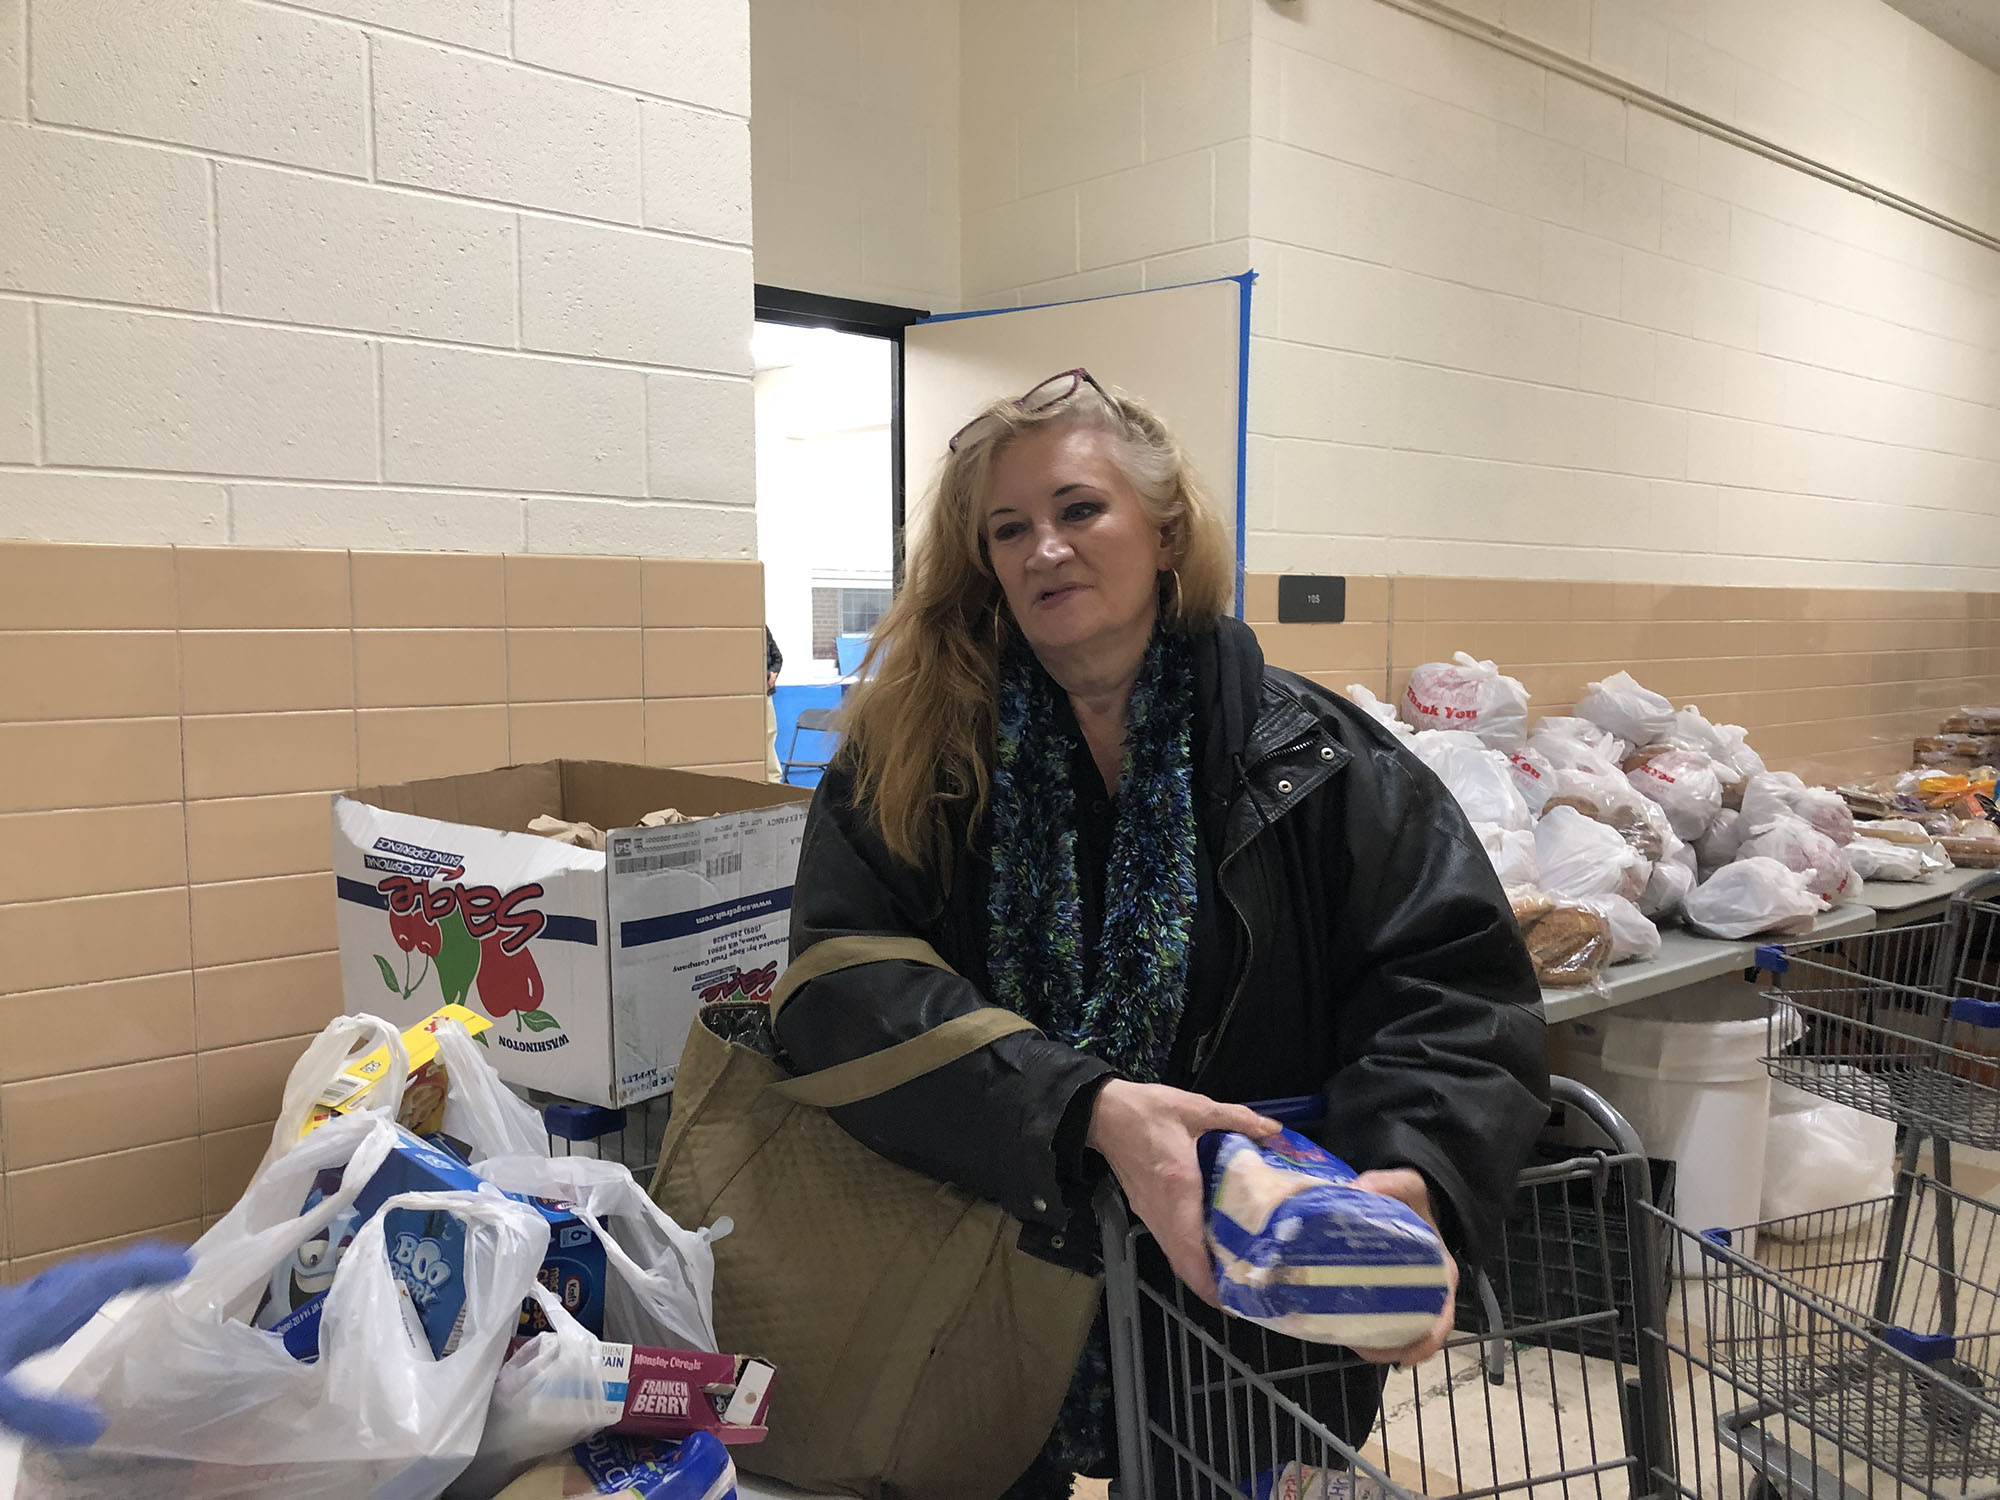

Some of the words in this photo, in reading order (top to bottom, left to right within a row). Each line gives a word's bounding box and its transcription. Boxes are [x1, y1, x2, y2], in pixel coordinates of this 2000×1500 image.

[1307, 594, 1321, 604] 105
[1405, 686, 1439, 717] Thank
[1444, 706, 1478, 720] You
[376, 838, 431, 861] EXPERIENCE
[366, 856, 421, 874] EXCEPTIONAL
[429, 852, 462, 866] EATING
[421, 865, 437, 876] AN
[377, 875, 546, 955] Sage
[695, 899, 773, 925] www.sagefruit.com
[738, 933, 768, 944] Yakima,
[711, 953, 728, 964] Fruit
[728, 948, 746, 957] Sage
[672, 959, 710, 973] Company
[698, 960, 778, 1003] Sage
[498, 1033, 570, 1053] WASHINGTON
[570, 1229, 588, 1241] 6
[393, 1233, 452, 1288] BOO
[567, 1282, 578, 1304] Kraft
[633, 1353, 669, 1369] Monster
[669, 1356, 702, 1371] Cereals
[640, 1379, 688, 1396] FRANKEN
[631, 1394, 689, 1416] BERRY
